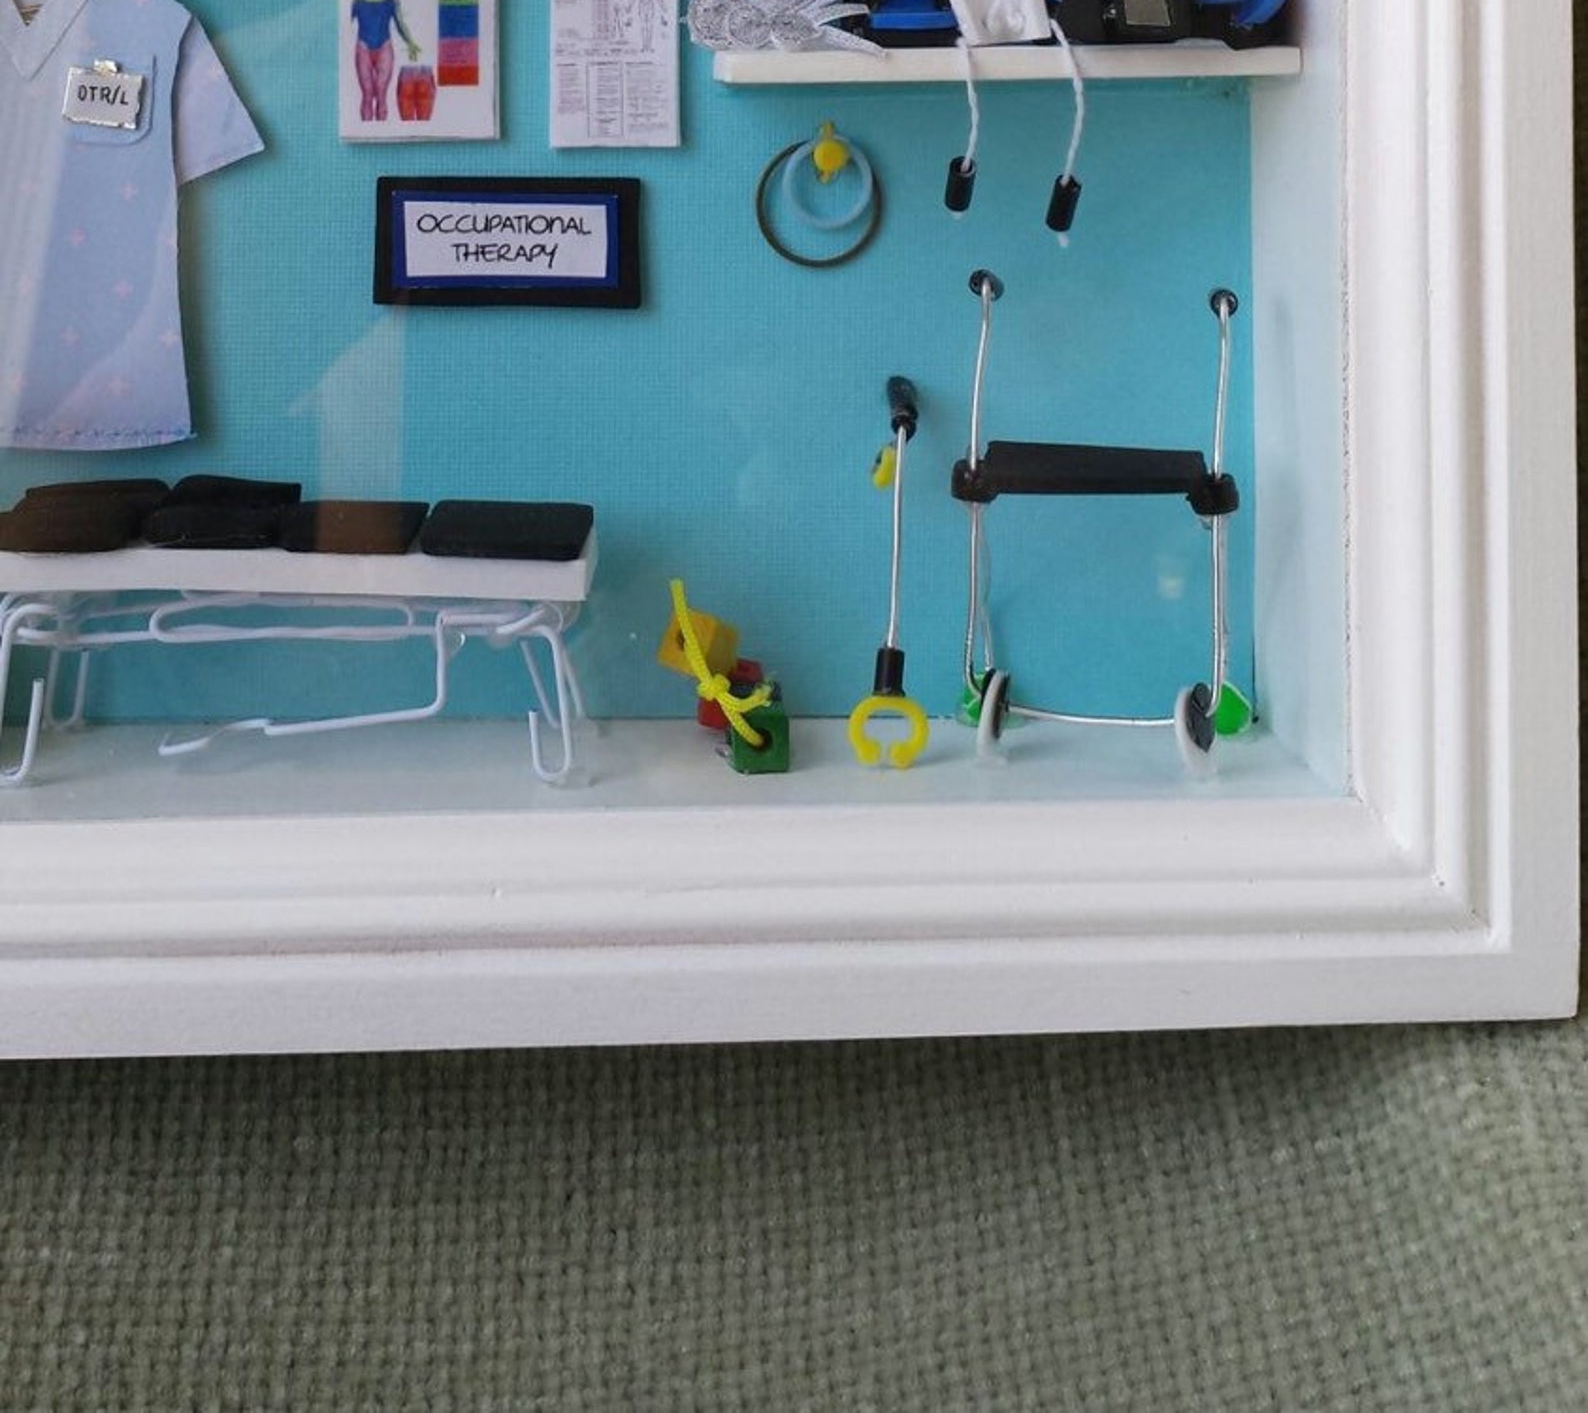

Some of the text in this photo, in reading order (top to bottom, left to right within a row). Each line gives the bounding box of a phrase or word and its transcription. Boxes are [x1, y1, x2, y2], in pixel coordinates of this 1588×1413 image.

[78, 84, 129, 106] OTR/L
[416, 213, 592, 235] OCCUPATIONAL
[453, 242, 559, 269] THERAPY
